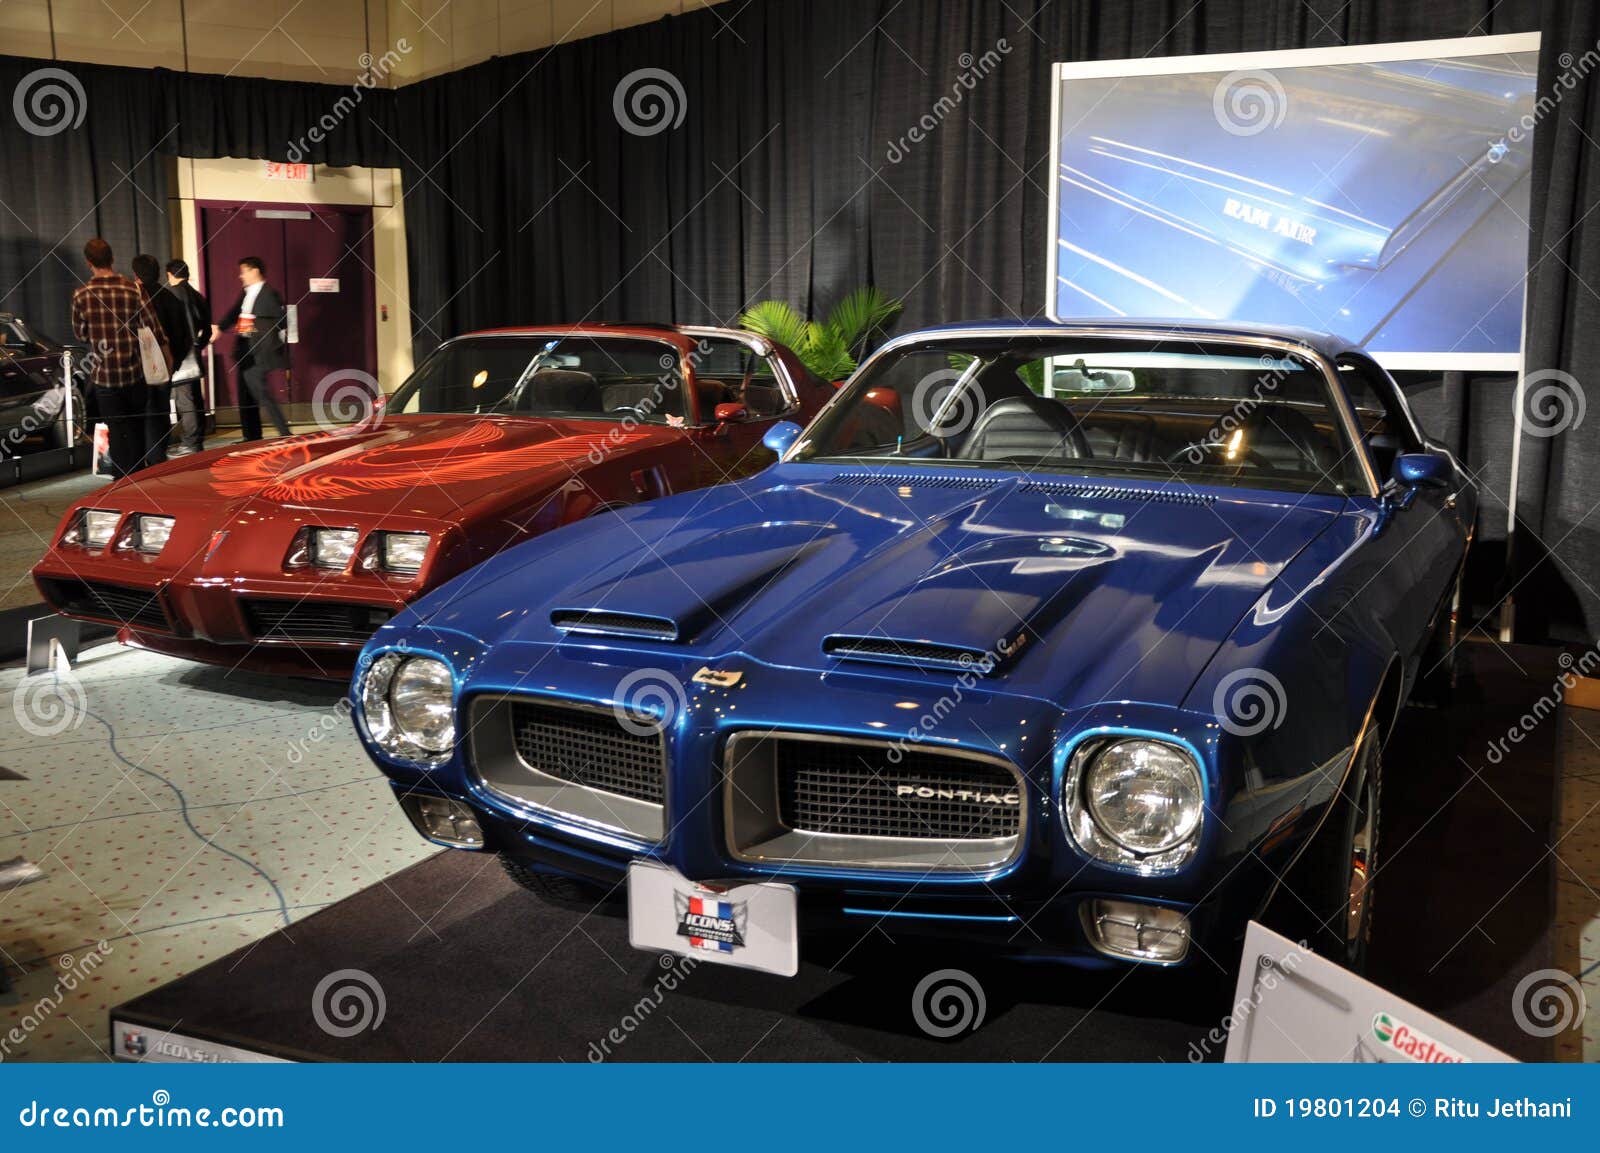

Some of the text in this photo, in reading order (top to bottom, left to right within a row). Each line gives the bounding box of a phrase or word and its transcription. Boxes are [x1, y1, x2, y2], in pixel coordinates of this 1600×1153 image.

[1223, 198, 1317, 246] RAM AIR
[897, 785, 1019, 804] PONTIAC
[686, 913, 734, 931] ICONS:
[1393, 1025, 1465, 1063] Castr
